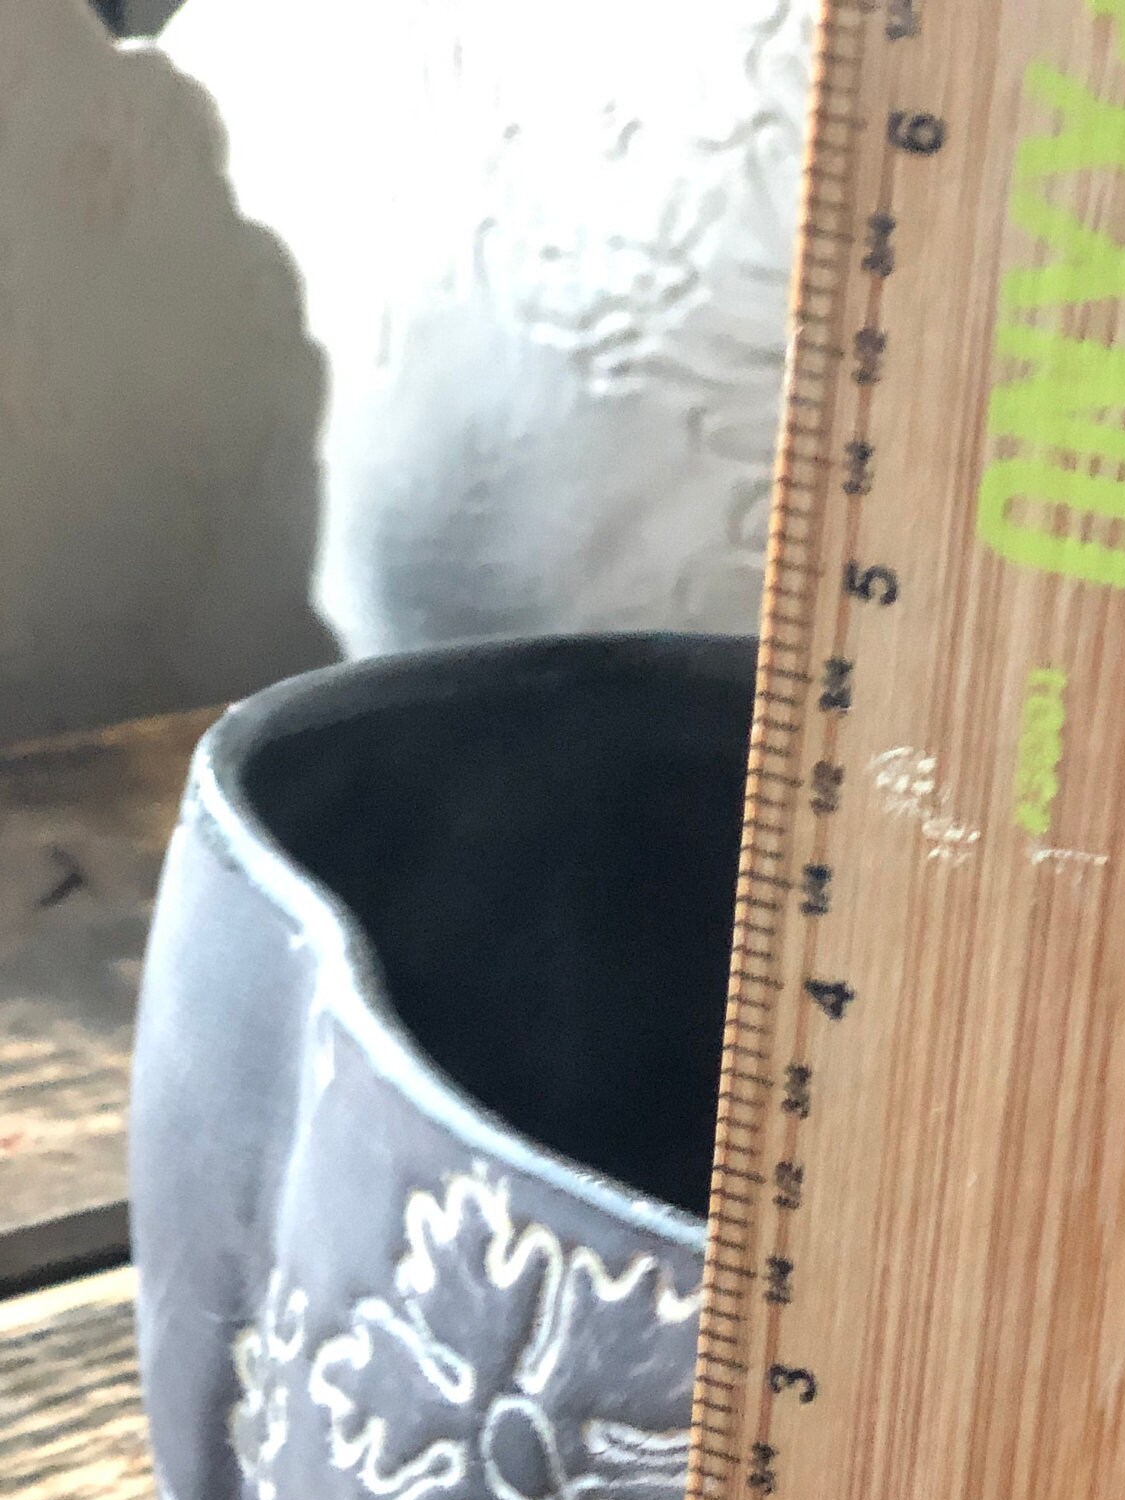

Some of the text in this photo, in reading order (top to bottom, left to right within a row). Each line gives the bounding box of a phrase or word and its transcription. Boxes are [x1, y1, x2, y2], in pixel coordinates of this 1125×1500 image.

[886, 112, 946, 158] 6
[842, 560, 898, 606] 5
[803, 978, 854, 1020] 4
[768, 1362, 818, 1404] 3
